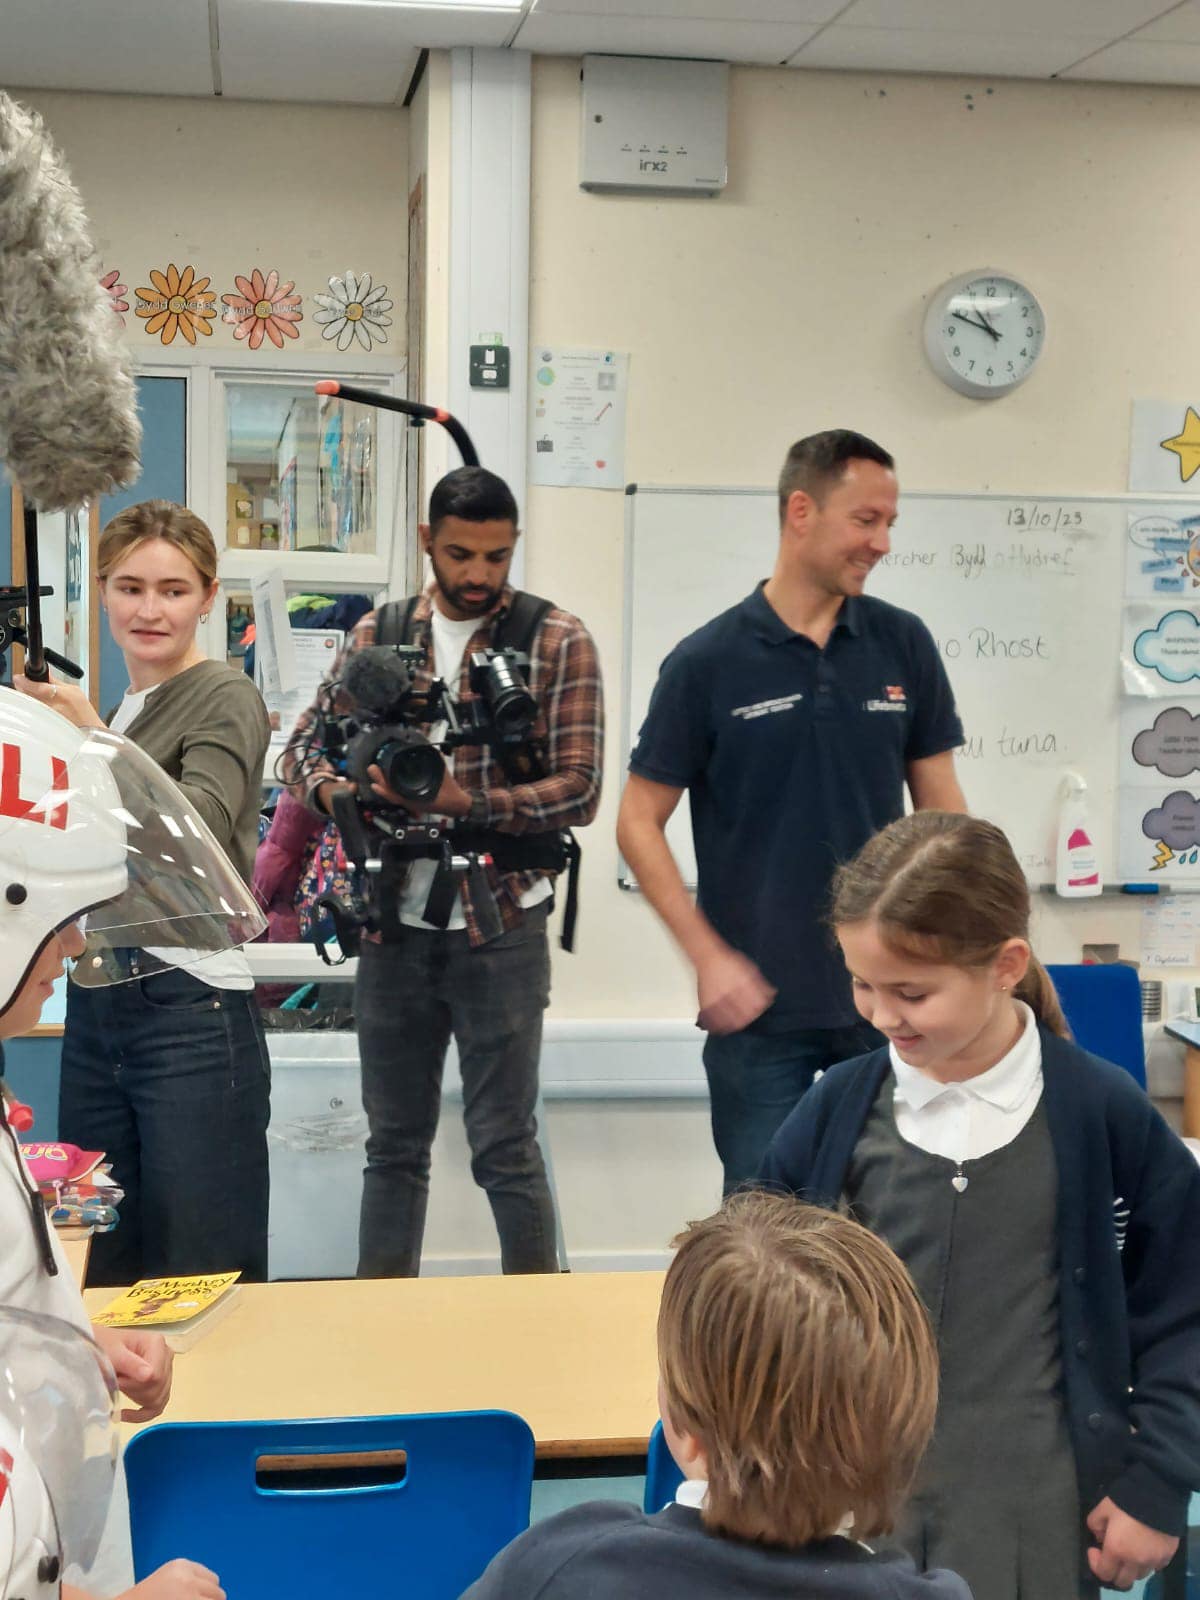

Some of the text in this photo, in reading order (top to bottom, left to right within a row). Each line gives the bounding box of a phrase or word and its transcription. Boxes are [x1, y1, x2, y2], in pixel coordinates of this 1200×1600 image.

[986, 286, 996, 298] 12
[1021, 306, 1029, 318] 2
[948, 326, 956, 338] 9
[1026, 326, 1034, 338] 3
[952, 346, 961, 357] 8
[1020, 347, 1027, 358] 4
[968, 360, 975, 371] 7
[1006, 361, 1014, 372] 5
[986, 366, 994, 377] 6
[968, 627, 1051, 660] Rhost
